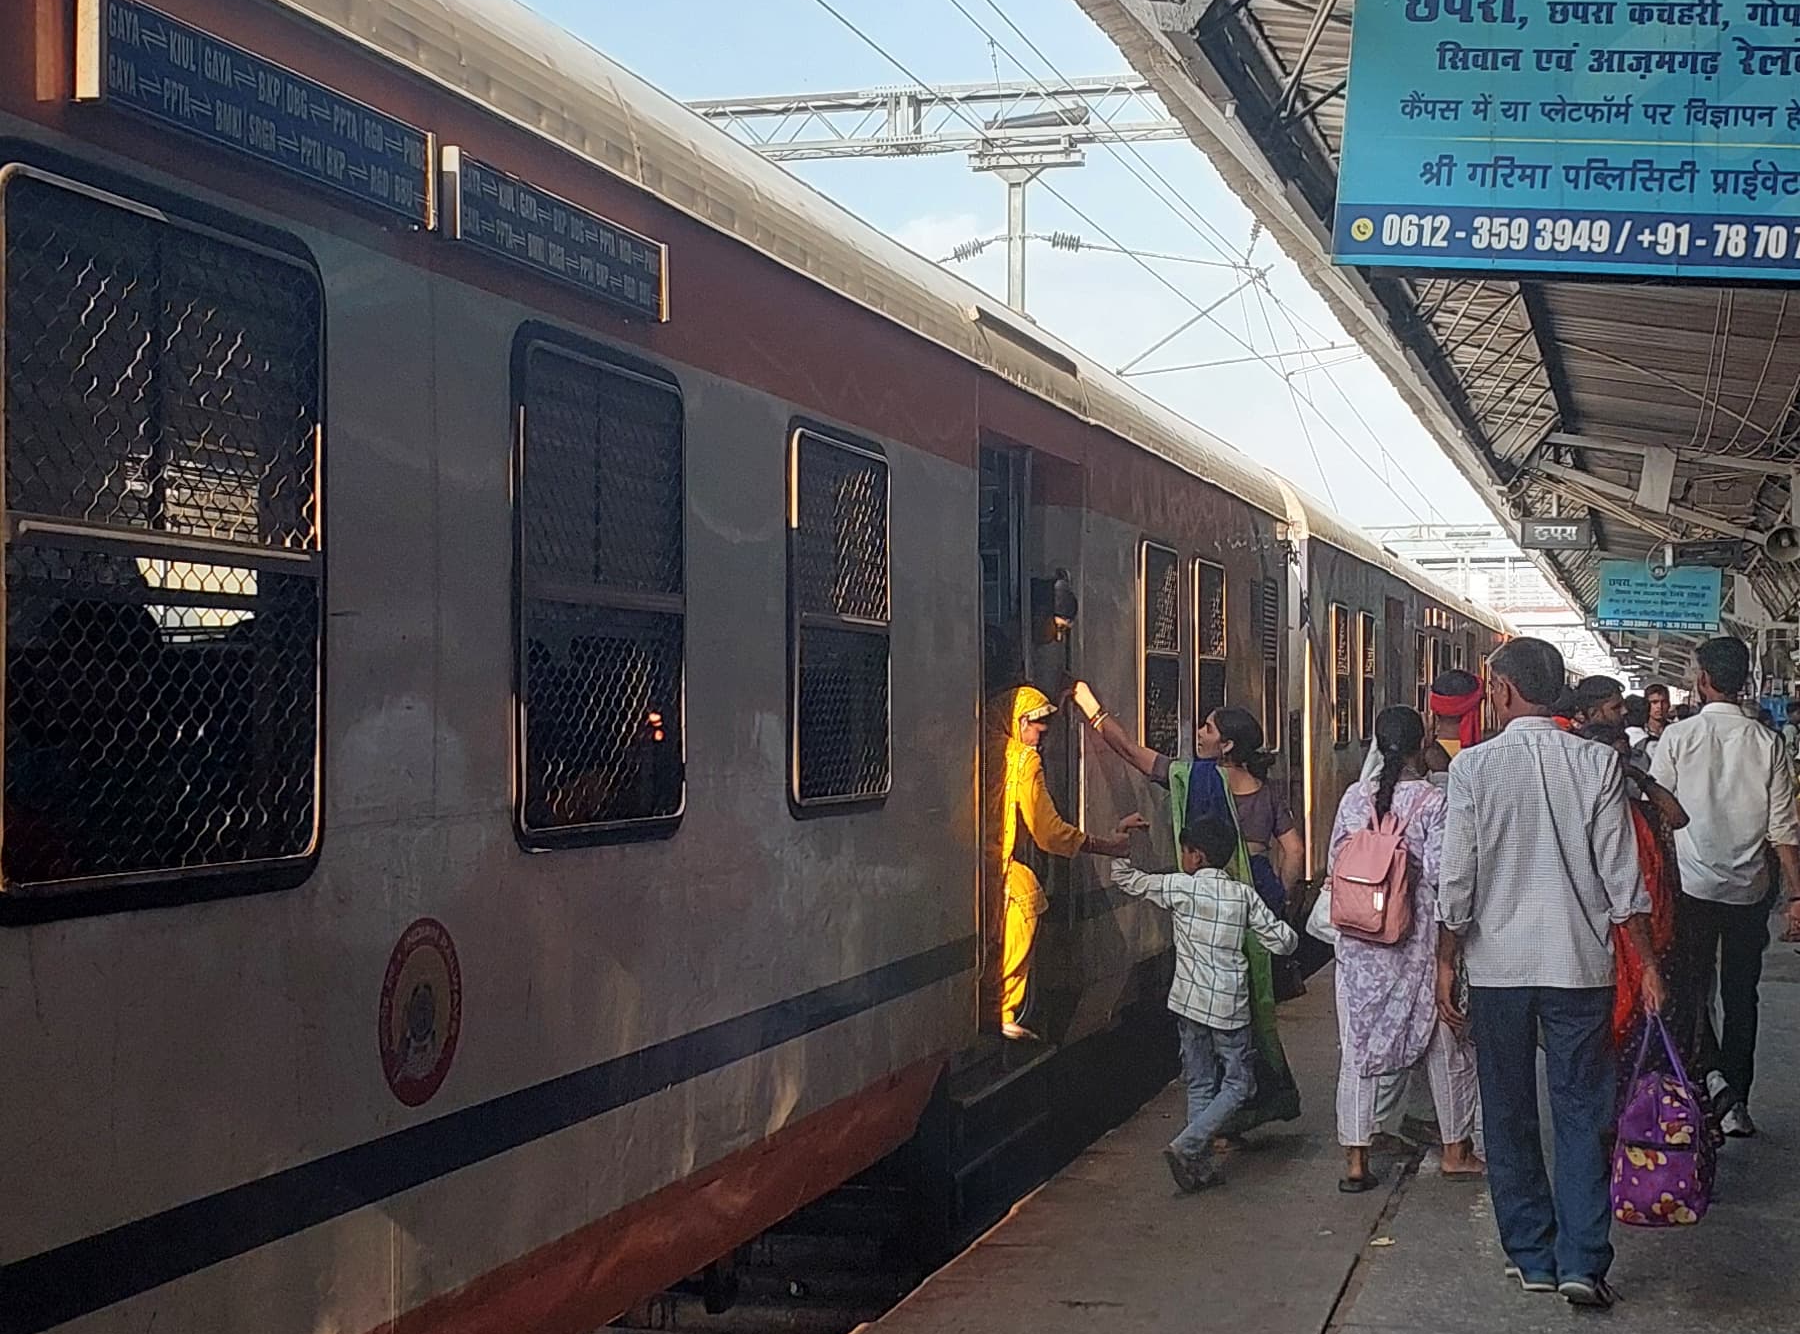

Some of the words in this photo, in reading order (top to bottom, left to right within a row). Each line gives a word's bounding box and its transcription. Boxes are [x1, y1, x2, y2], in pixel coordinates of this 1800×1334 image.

[1547, 1, 1617, 25] छपरा
[108, 2, 140, 46] GAYA
[169, 30, 196, 71] KIUL
[204, 46, 232, 88] GAYA
[1437, 41, 1523, 72] सिवान
[1532, 42, 1579, 72] एवं
[108, 54, 137, 97] GAYA
[1400, 90, 1463, 121] कैंपस
[1472, 92, 1493, 121] में
[1500, 101, 1531, 122] या
[1540, 94, 1634, 124] प्लेटफॉर्म
[1642, 104, 1676, 125] पर
[1684, 98, 1778, 129] विज्ञापन
[1420, 154, 1457, 187] श्री
[1467, 156, 1553, 189] गरिमा
[1382, 214, 1451, 248] 0612
[1471, 216, 1529, 251] 359
[1535, 218, 1610, 253] 3949
[1637, 222, 1690, 256] +91
[1713, 224, 1747, 257] 78
[1753, 225, 1788, 259] 70
